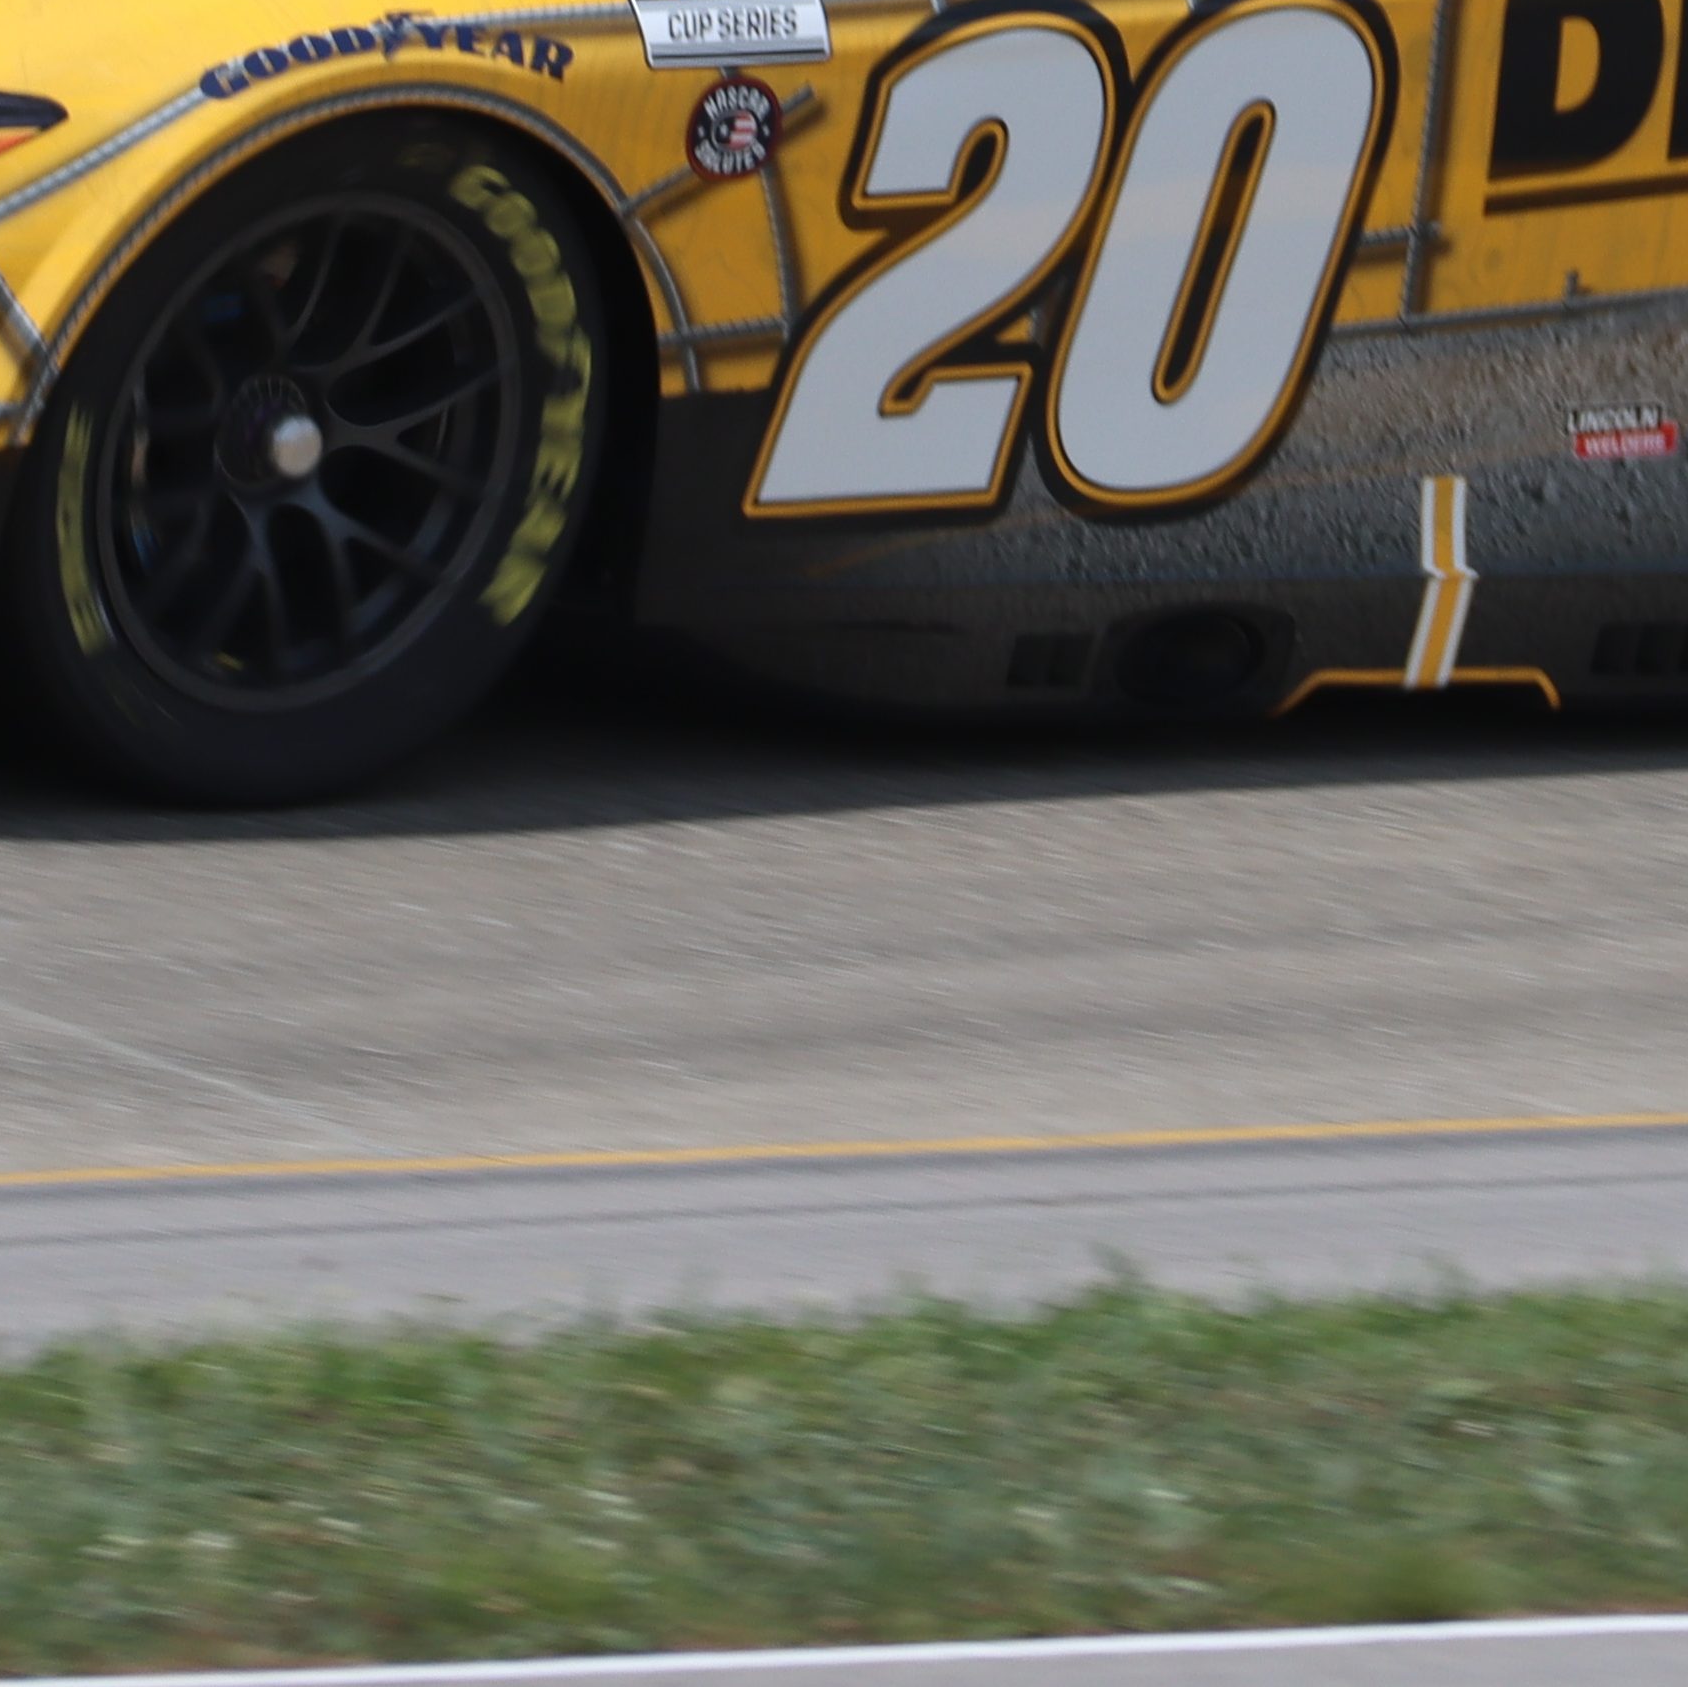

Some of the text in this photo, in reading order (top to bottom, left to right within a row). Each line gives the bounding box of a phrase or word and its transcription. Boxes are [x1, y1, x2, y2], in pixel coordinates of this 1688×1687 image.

[667, 6, 798, 41] CUP SERIES
[198, 12, 575, 99] GOODYEAR
[703, 84, 771, 121] NASCAR
[1567, 404, 1661, 433] LINCOLN
